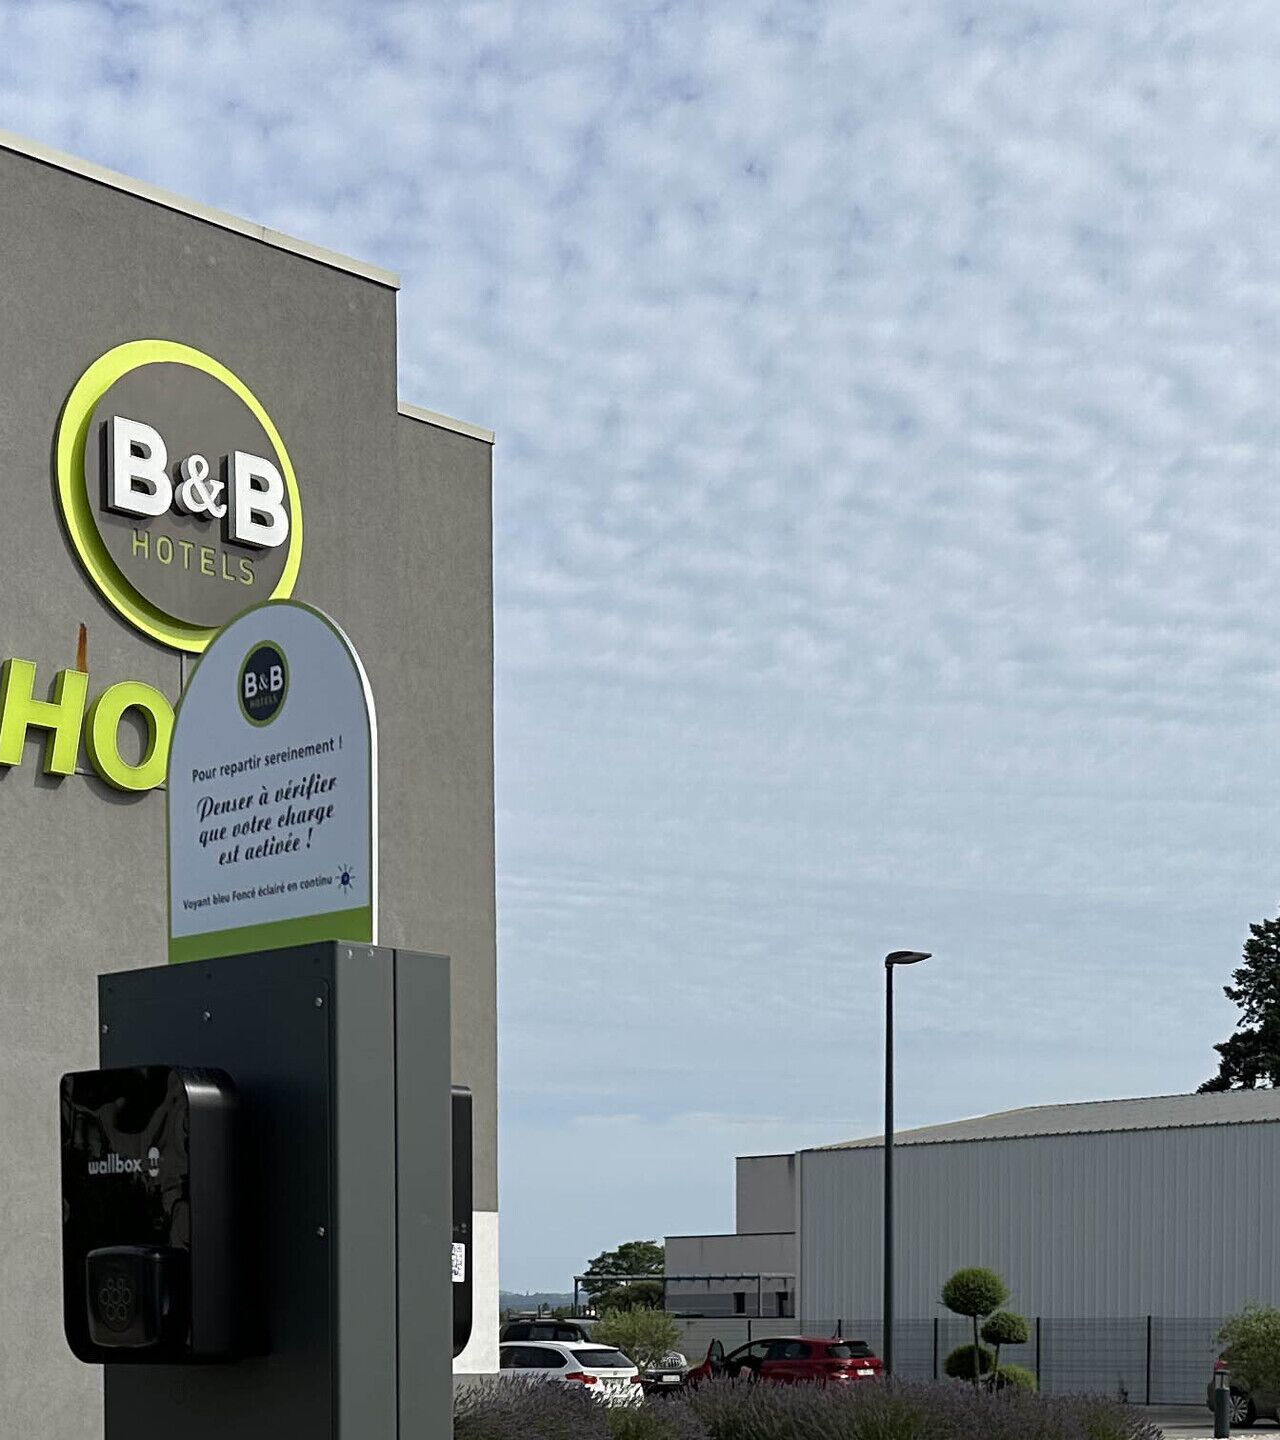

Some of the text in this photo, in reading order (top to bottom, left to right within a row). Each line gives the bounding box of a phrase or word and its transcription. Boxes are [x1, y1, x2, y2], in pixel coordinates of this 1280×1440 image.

[113, 415, 289, 549] B&B
[132, 529, 256, 586] HOTELS
[244, 664, 283, 699] B&B
[192, 767, 217, 783] Pour
[220, 755, 261, 779] repartir
[264, 737, 334, 767] sereinement
[196, 773, 337, 823] Penser à vérifier
[199, 804, 335, 848] que votre charge
[218, 827, 313, 866] est activée !
[182, 897, 211, 911] Voyant
[213, 892, 231, 906] bleu
[257, 882, 285, 898] éclairé
[287, 882, 298, 891] en
[299, 875, 334, 890] continu
[88, 1153, 142, 1175] wallbox
